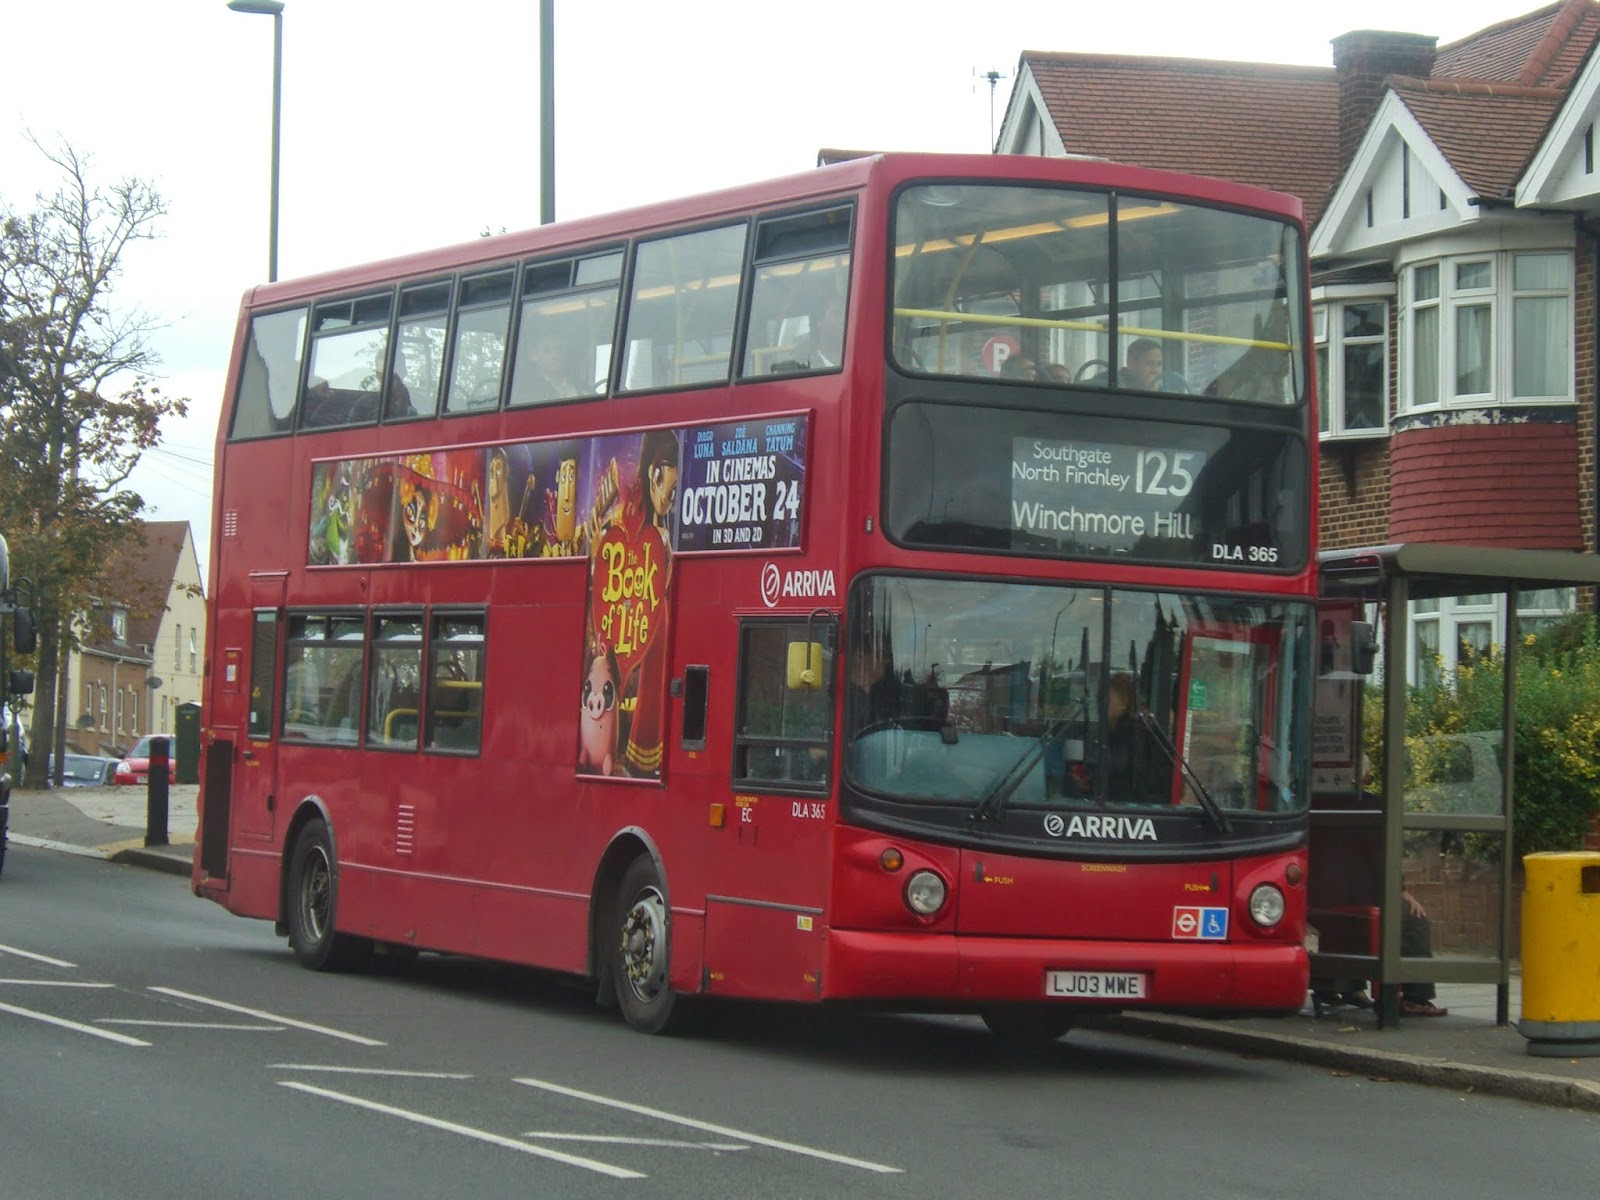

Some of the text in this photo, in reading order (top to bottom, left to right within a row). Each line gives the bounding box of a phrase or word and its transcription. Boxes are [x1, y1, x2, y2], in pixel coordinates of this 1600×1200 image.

[697, 431, 714, 442] DIEGO
[766, 423, 795, 435] CHANNING
[694, 443, 714, 458] LUNA
[721, 438, 758, 457] SALDANA
[766, 435, 793, 452] TATUM
[1033, 441, 1112, 468] Southgate
[706, 455, 776, 484] IN CINEMAS
[1011, 461, 1131, 492] North Finchley
[1135, 449, 1195, 498] 125
[682, 480, 800, 525] OCTOBER 24
[1011, 500, 1194, 540] Winchmore Hill
[712, 527, 763, 544] IN 3D AND 2D
[627, 550, 638, 566] the
[1212, 543, 1279, 563] DLA 365
[602, 541, 660, 613] Book
[782, 570, 836, 597] ARRIVA
[601, 601, 649, 658] of Life
[741, 807, 753, 823] EC
[792, 802, 826, 820] DLA 365
[1065, 815, 1158, 841] ARRIVA
[994, 876, 1014, 885] PUSH
[1053, 974, 1139, 995] LJ03 MWE
